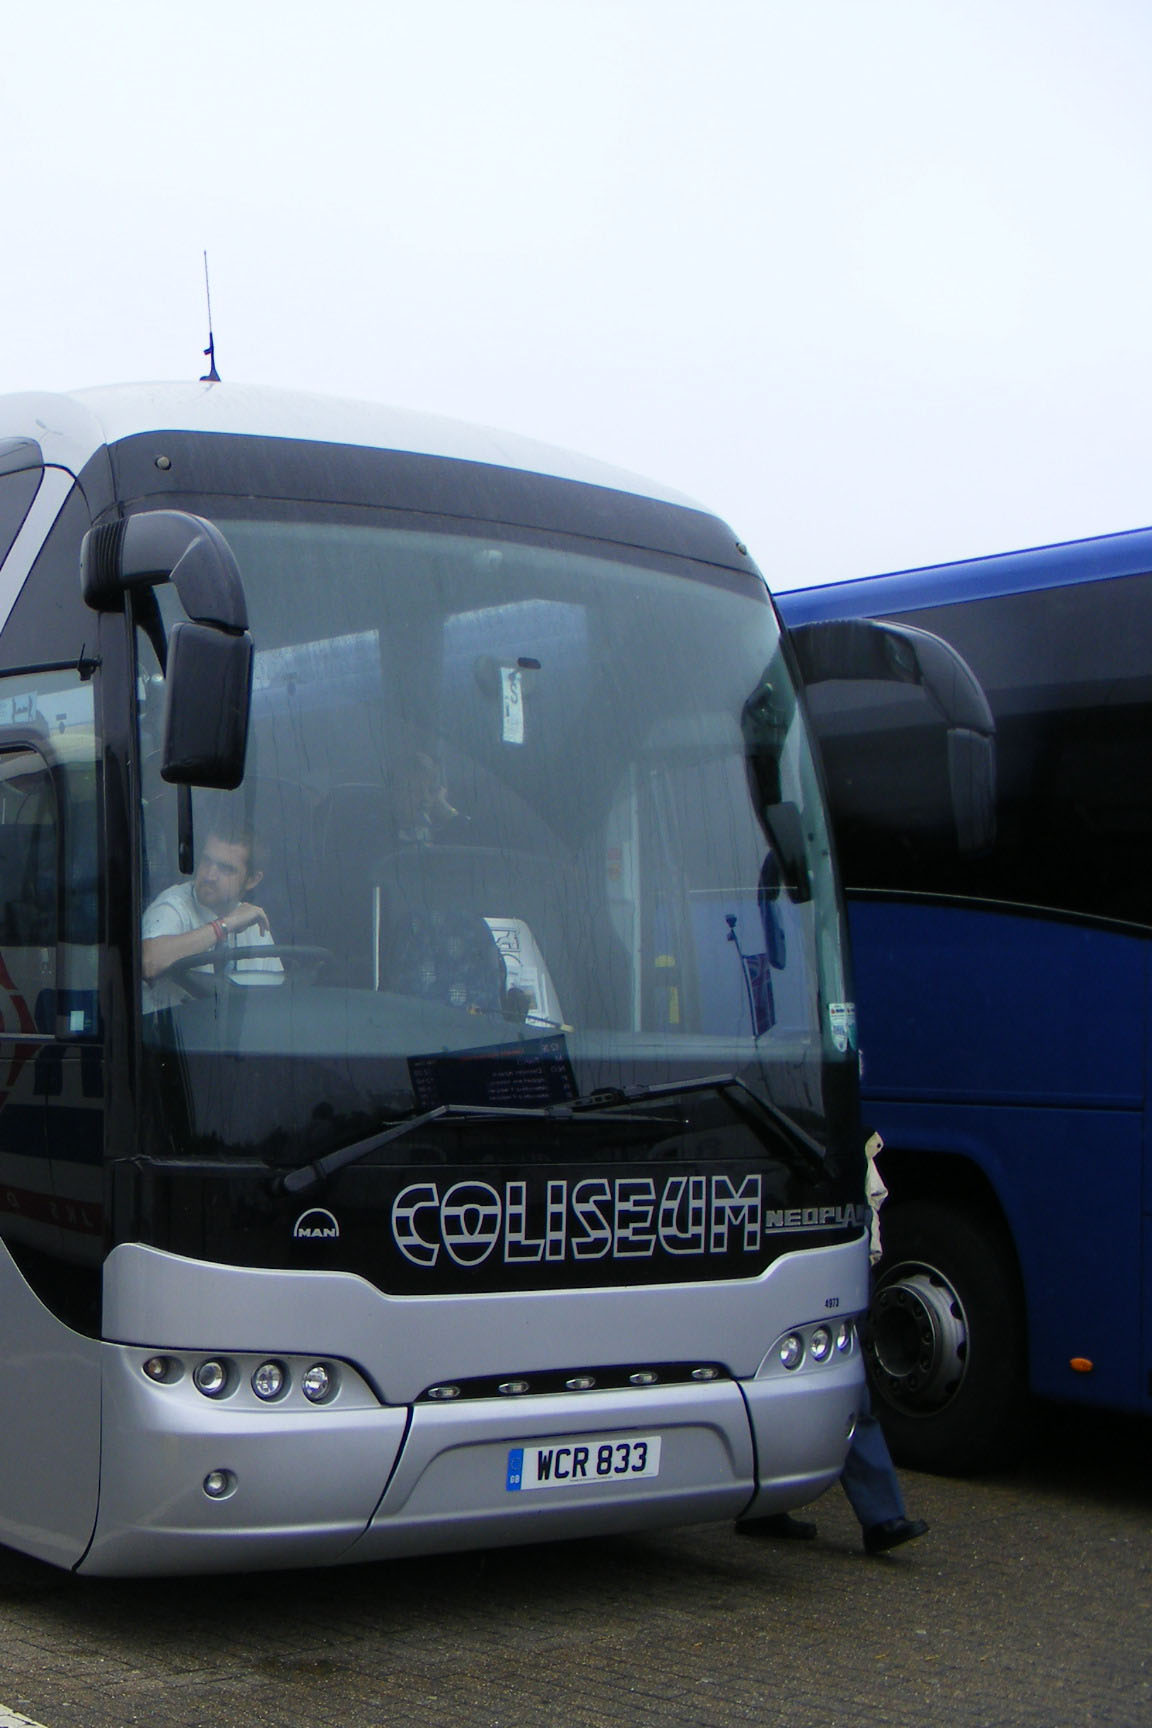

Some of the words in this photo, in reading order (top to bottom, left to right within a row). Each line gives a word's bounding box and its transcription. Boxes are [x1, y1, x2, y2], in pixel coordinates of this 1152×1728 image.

[298, 1228, 336, 1237] MAN
[391, 1174, 762, 1266] COLISEUM
[537, 1446, 589, 1481] WCR
[596, 1442, 648, 1475] 833
